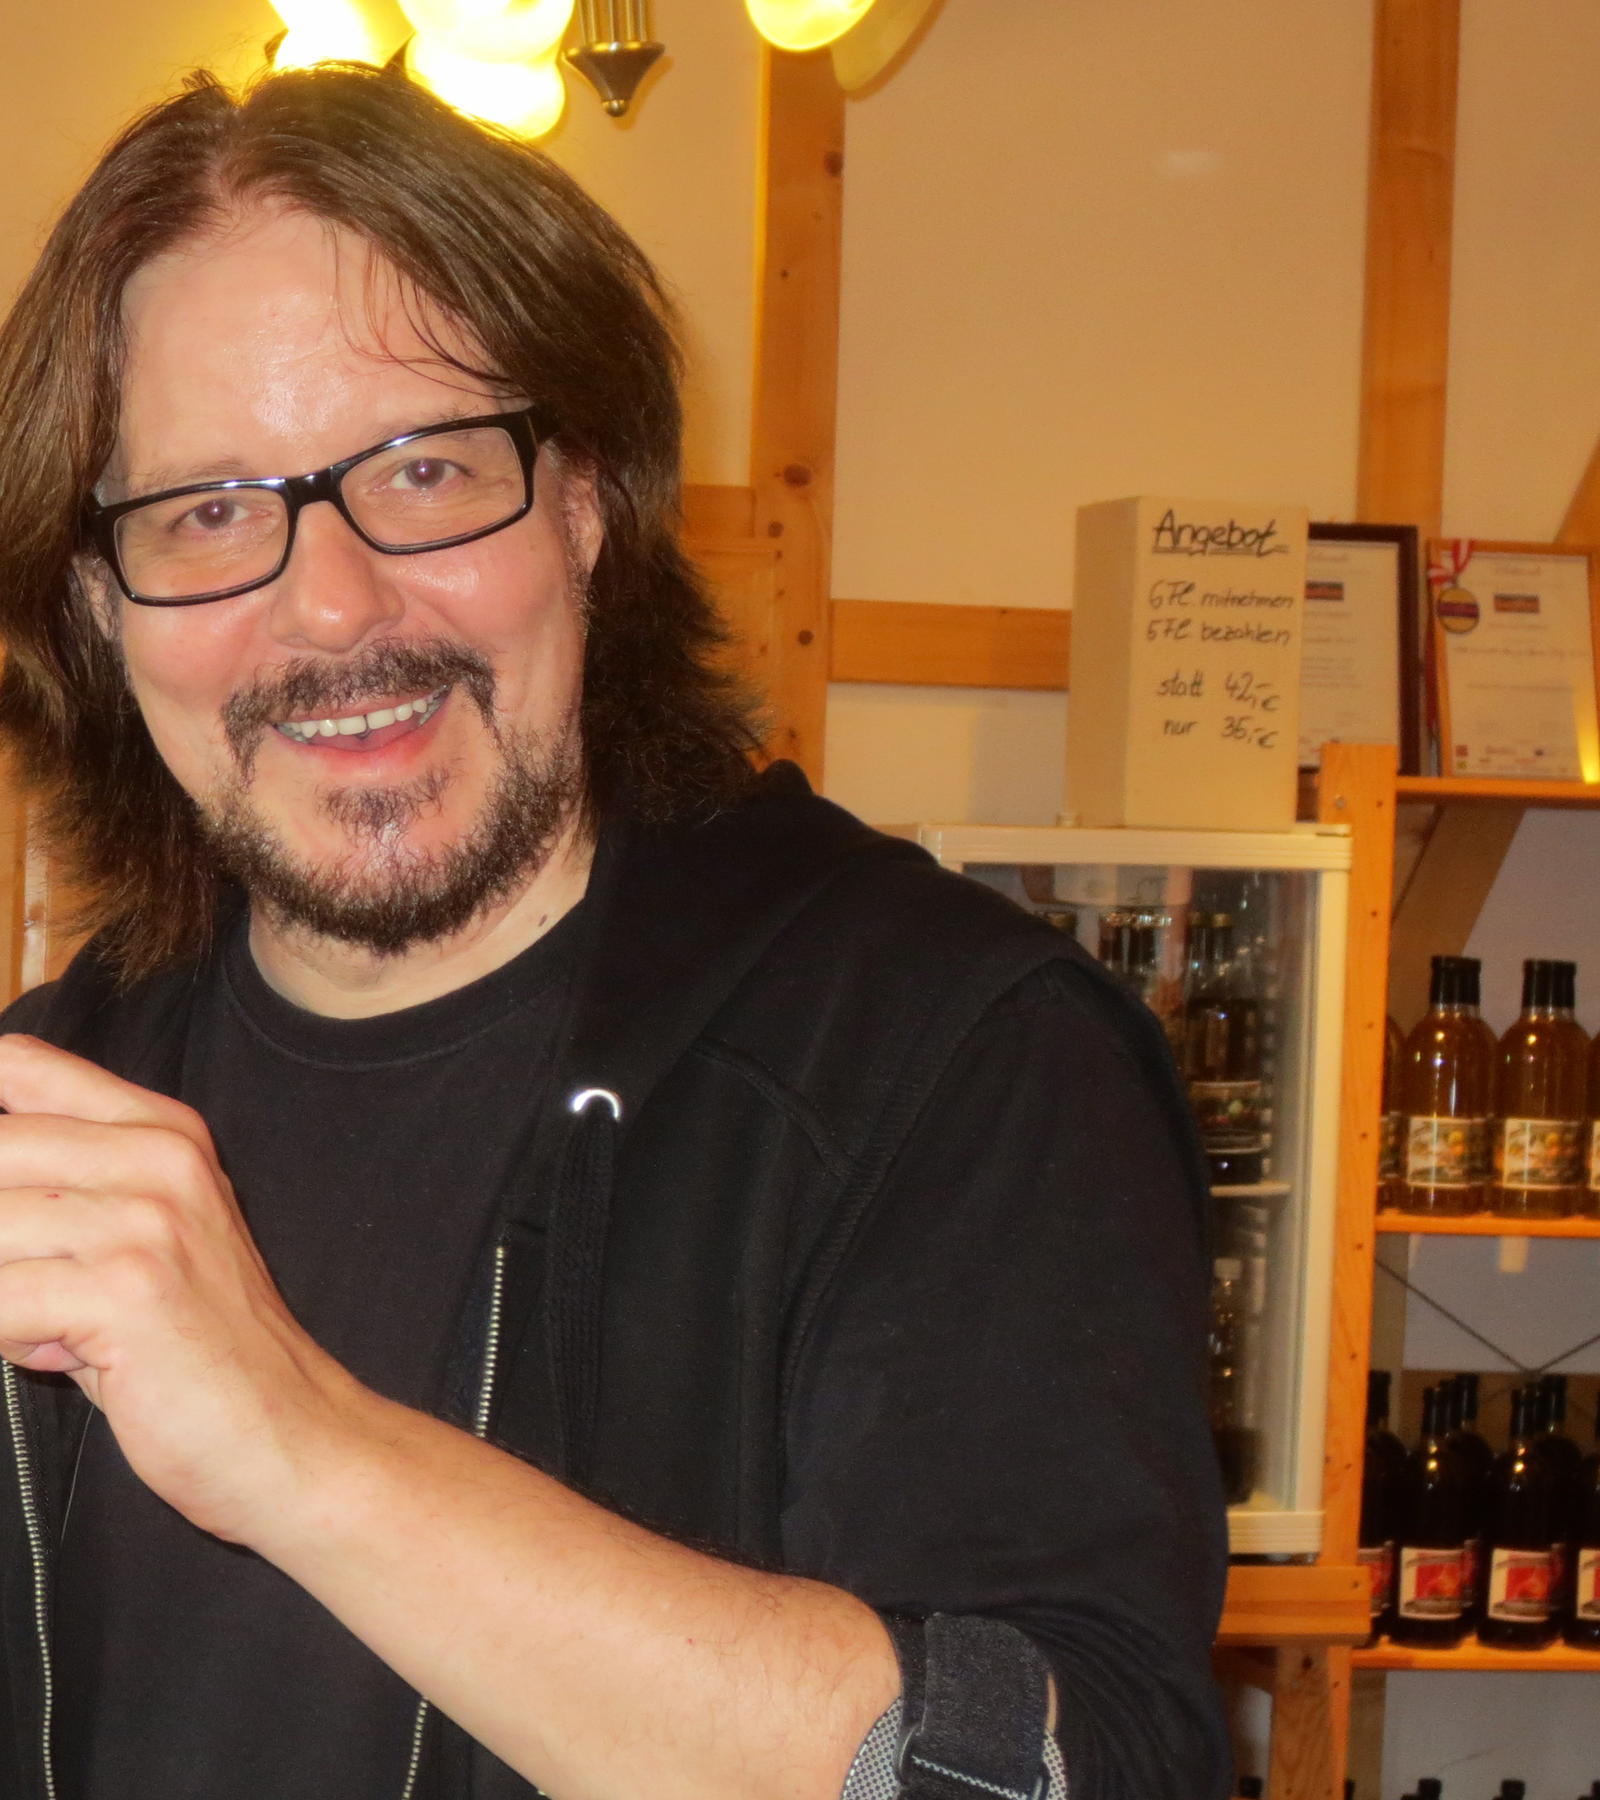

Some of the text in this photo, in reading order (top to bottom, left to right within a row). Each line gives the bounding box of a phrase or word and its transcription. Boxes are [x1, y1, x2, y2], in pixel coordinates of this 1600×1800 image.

[1153, 508, 1278, 558] Angebot
[1201, 621, 1291, 647] bezahlen
[1156, 668, 1204, 698] statt
[1163, 718, 1199, 736] nur
